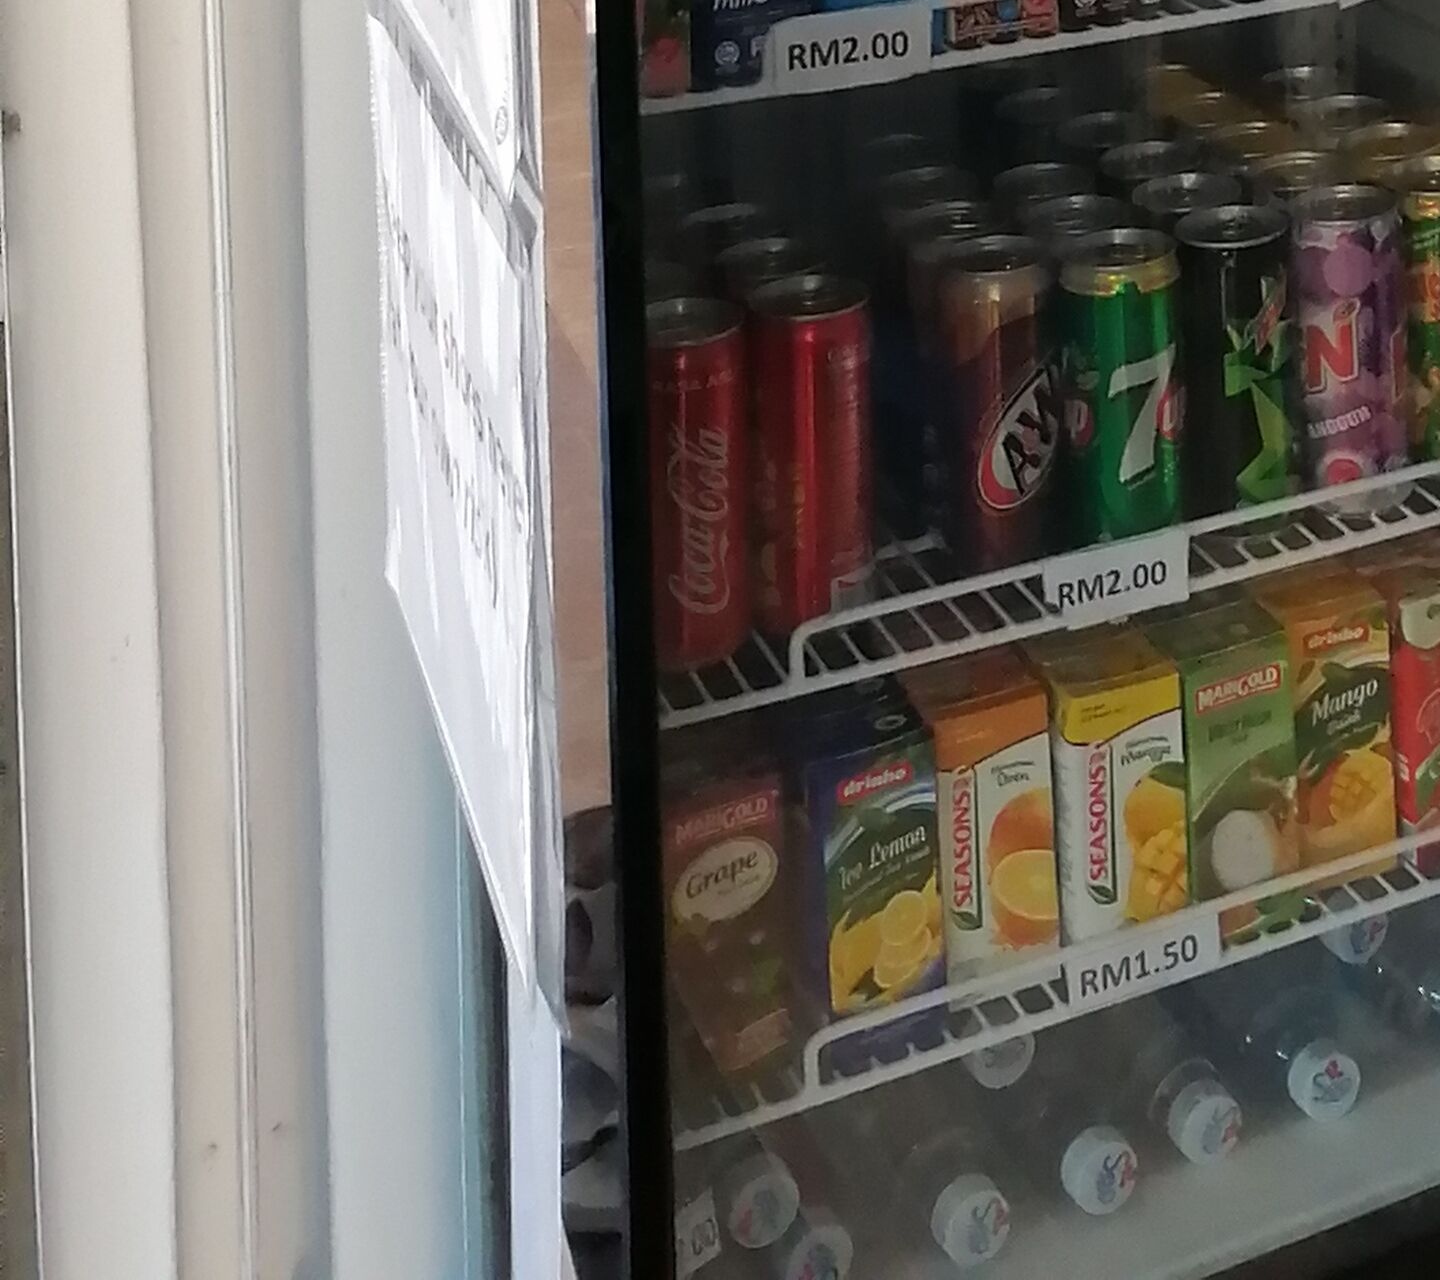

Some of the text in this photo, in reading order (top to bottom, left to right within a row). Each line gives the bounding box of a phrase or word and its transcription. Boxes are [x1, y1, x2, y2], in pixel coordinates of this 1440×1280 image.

[786, 30, 910, 72] RM2.00
[1057, 560, 1168, 608] RM2.00
[1196, 665, 1279, 710] MARIGOLD
[1311, 677, 1380, 726] Mango
[1087, 761, 1108, 881] SEASONS
[868, 824, 927, 870] Lemon
[952, 789, 974, 908] SEASONS
[685, 848, 759, 900] Grape
[1079, 934, 1199, 999] RM1.50
